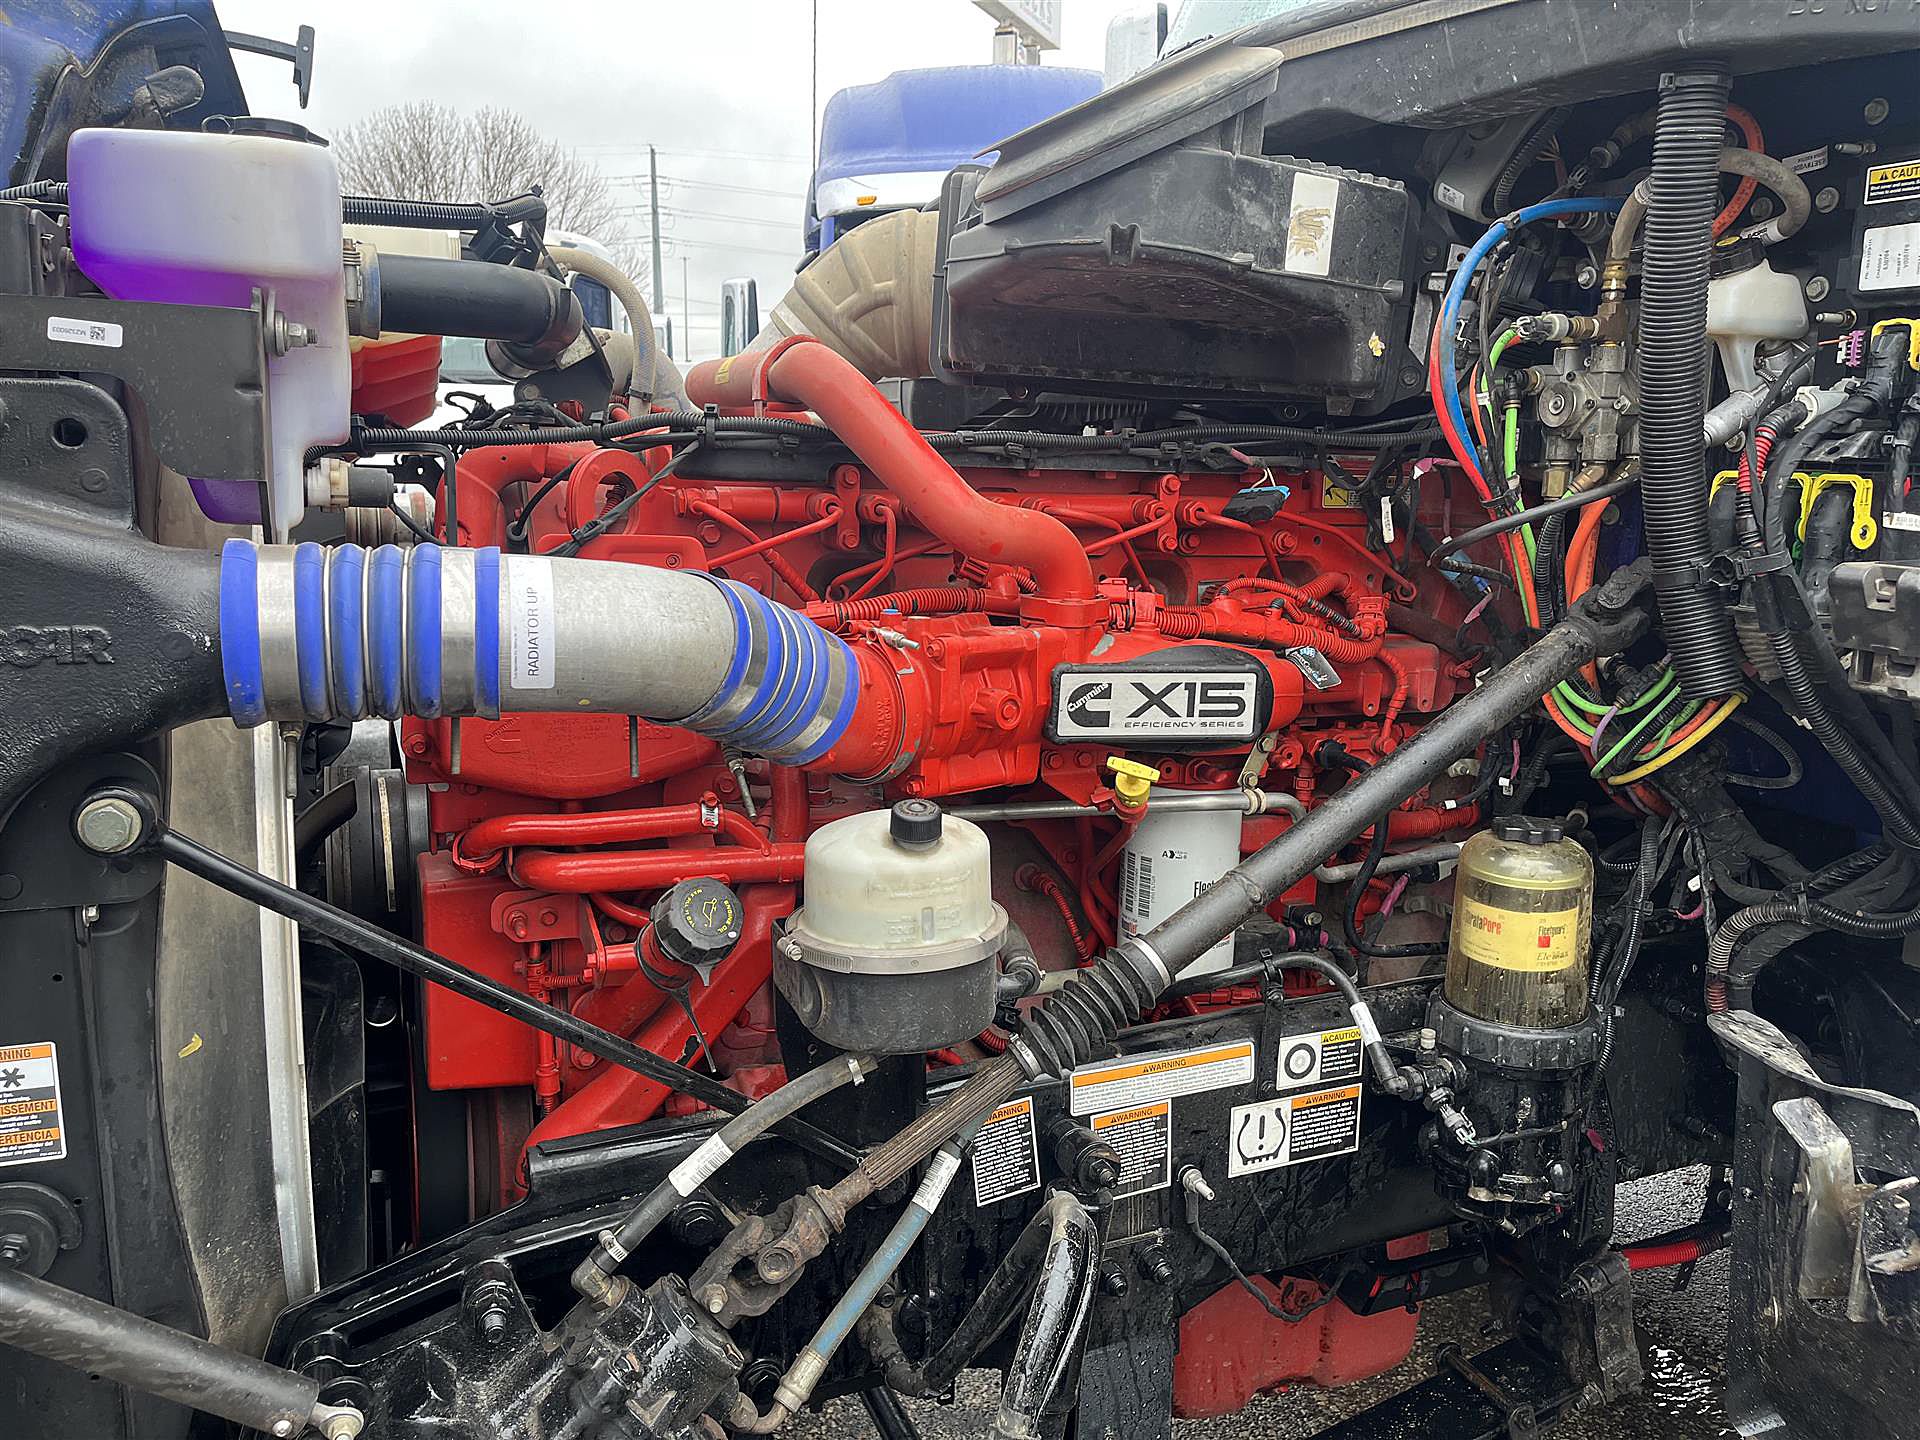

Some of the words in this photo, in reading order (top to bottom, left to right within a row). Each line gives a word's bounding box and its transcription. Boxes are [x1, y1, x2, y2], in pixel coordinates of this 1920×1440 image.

[527, 587, 539, 604] UP
[0, 625, 114, 665] CAR
[528, 608, 539, 677] RADIATOR
[1067, 683, 1110, 712] Cummins
[1126, 682, 1247, 718] X15
[723, 900, 734, 926] ENGINE
[717, 924, 728, 933] OIL
[1329, 1030, 1361, 1042] CAUTION
[1148, 1058, 1187, 1072] WARNING
[1311, 1091, 1346, 1103] WARNING
[1116, 1108, 1153, 1123] WARNING
